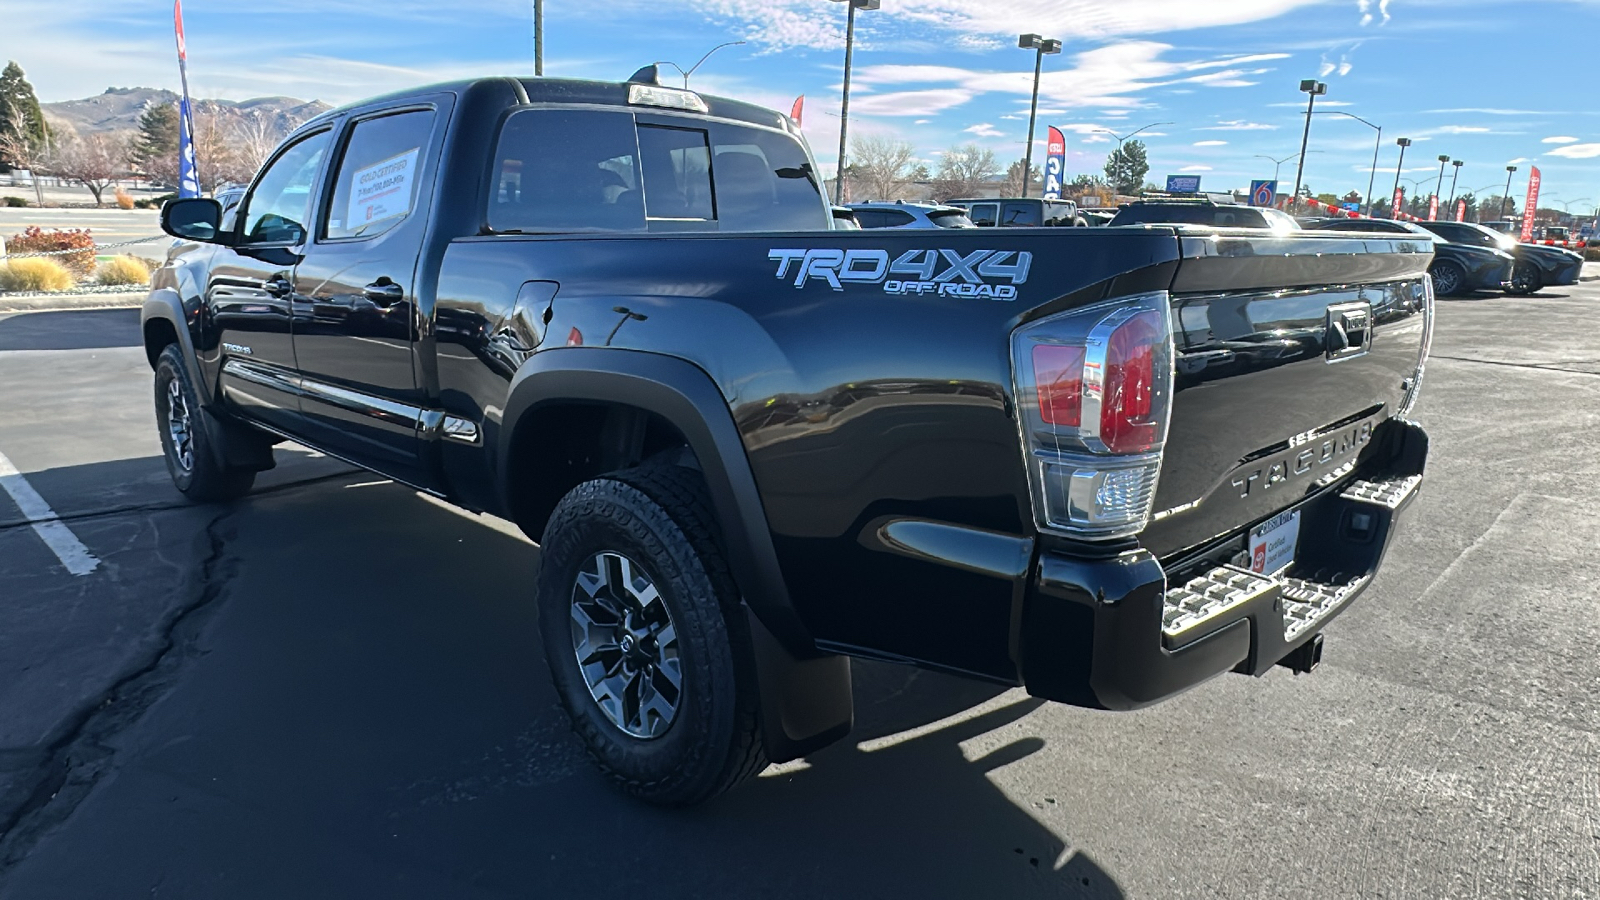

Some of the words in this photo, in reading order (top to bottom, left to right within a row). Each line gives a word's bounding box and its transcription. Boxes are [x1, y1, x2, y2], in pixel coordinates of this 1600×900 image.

[1254, 182, 1271, 206] 6
[768, 249, 891, 291] TRD
[1231, 421, 1372, 499] TACOMA
